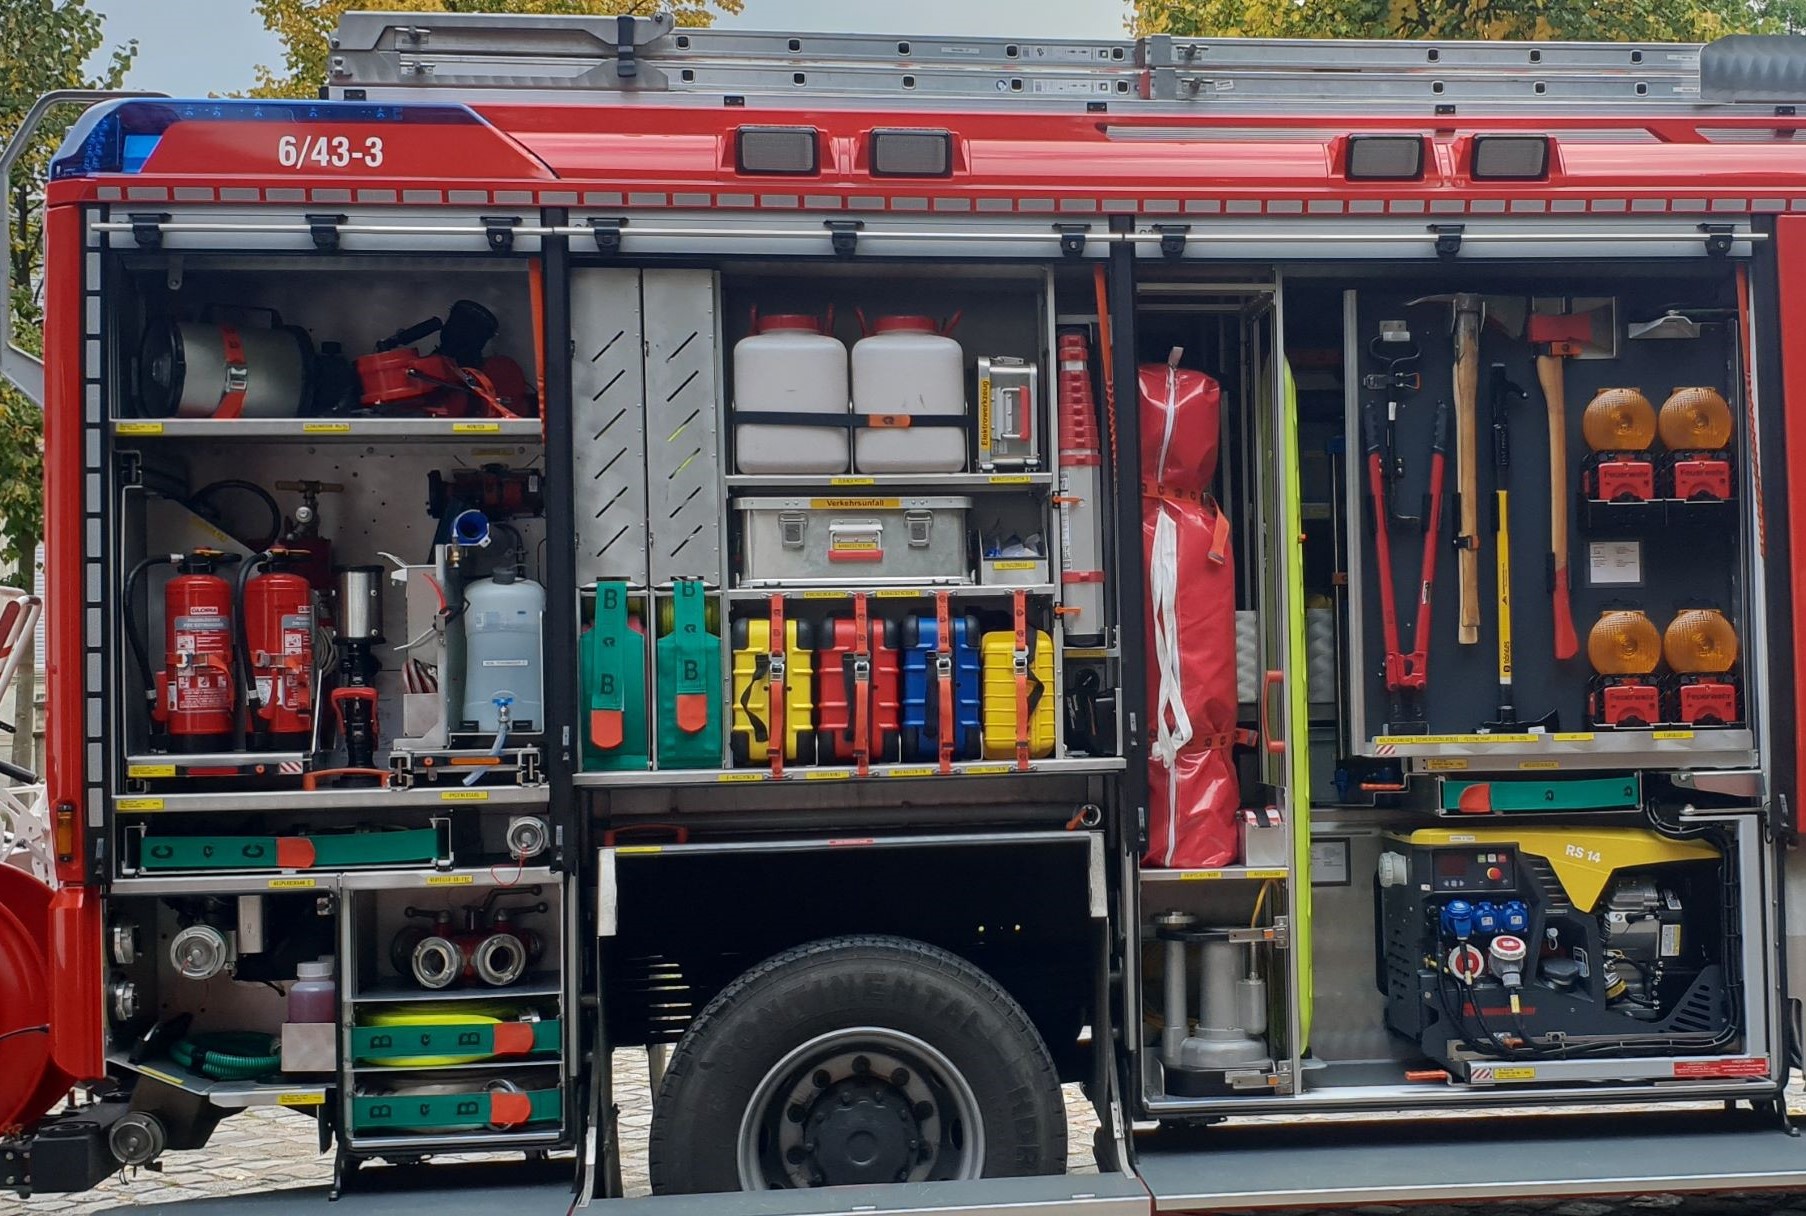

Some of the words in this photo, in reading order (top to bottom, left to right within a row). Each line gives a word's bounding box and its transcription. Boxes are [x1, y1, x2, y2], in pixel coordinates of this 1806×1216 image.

[279, 135, 383, 169] 6/43-3
[981, 381, 989, 447] Elektrowerkzeug
[827, 499, 884, 507] Verkehrsunfall
[604, 588, 618, 609] B
[682, 581, 696, 598] B
[191, 607, 217, 615] GLORIA
[685, 660, 699, 681] B
[601, 674, 615, 695] B
[1565, 844, 1585, 859] RS
[1587, 850, 1601, 864] 14
[370, 1034, 392, 1049] B
[458, 1032, 480, 1045] B
[370, 1104, 392, 1119] B
[457, 1101, 479, 1115] B
